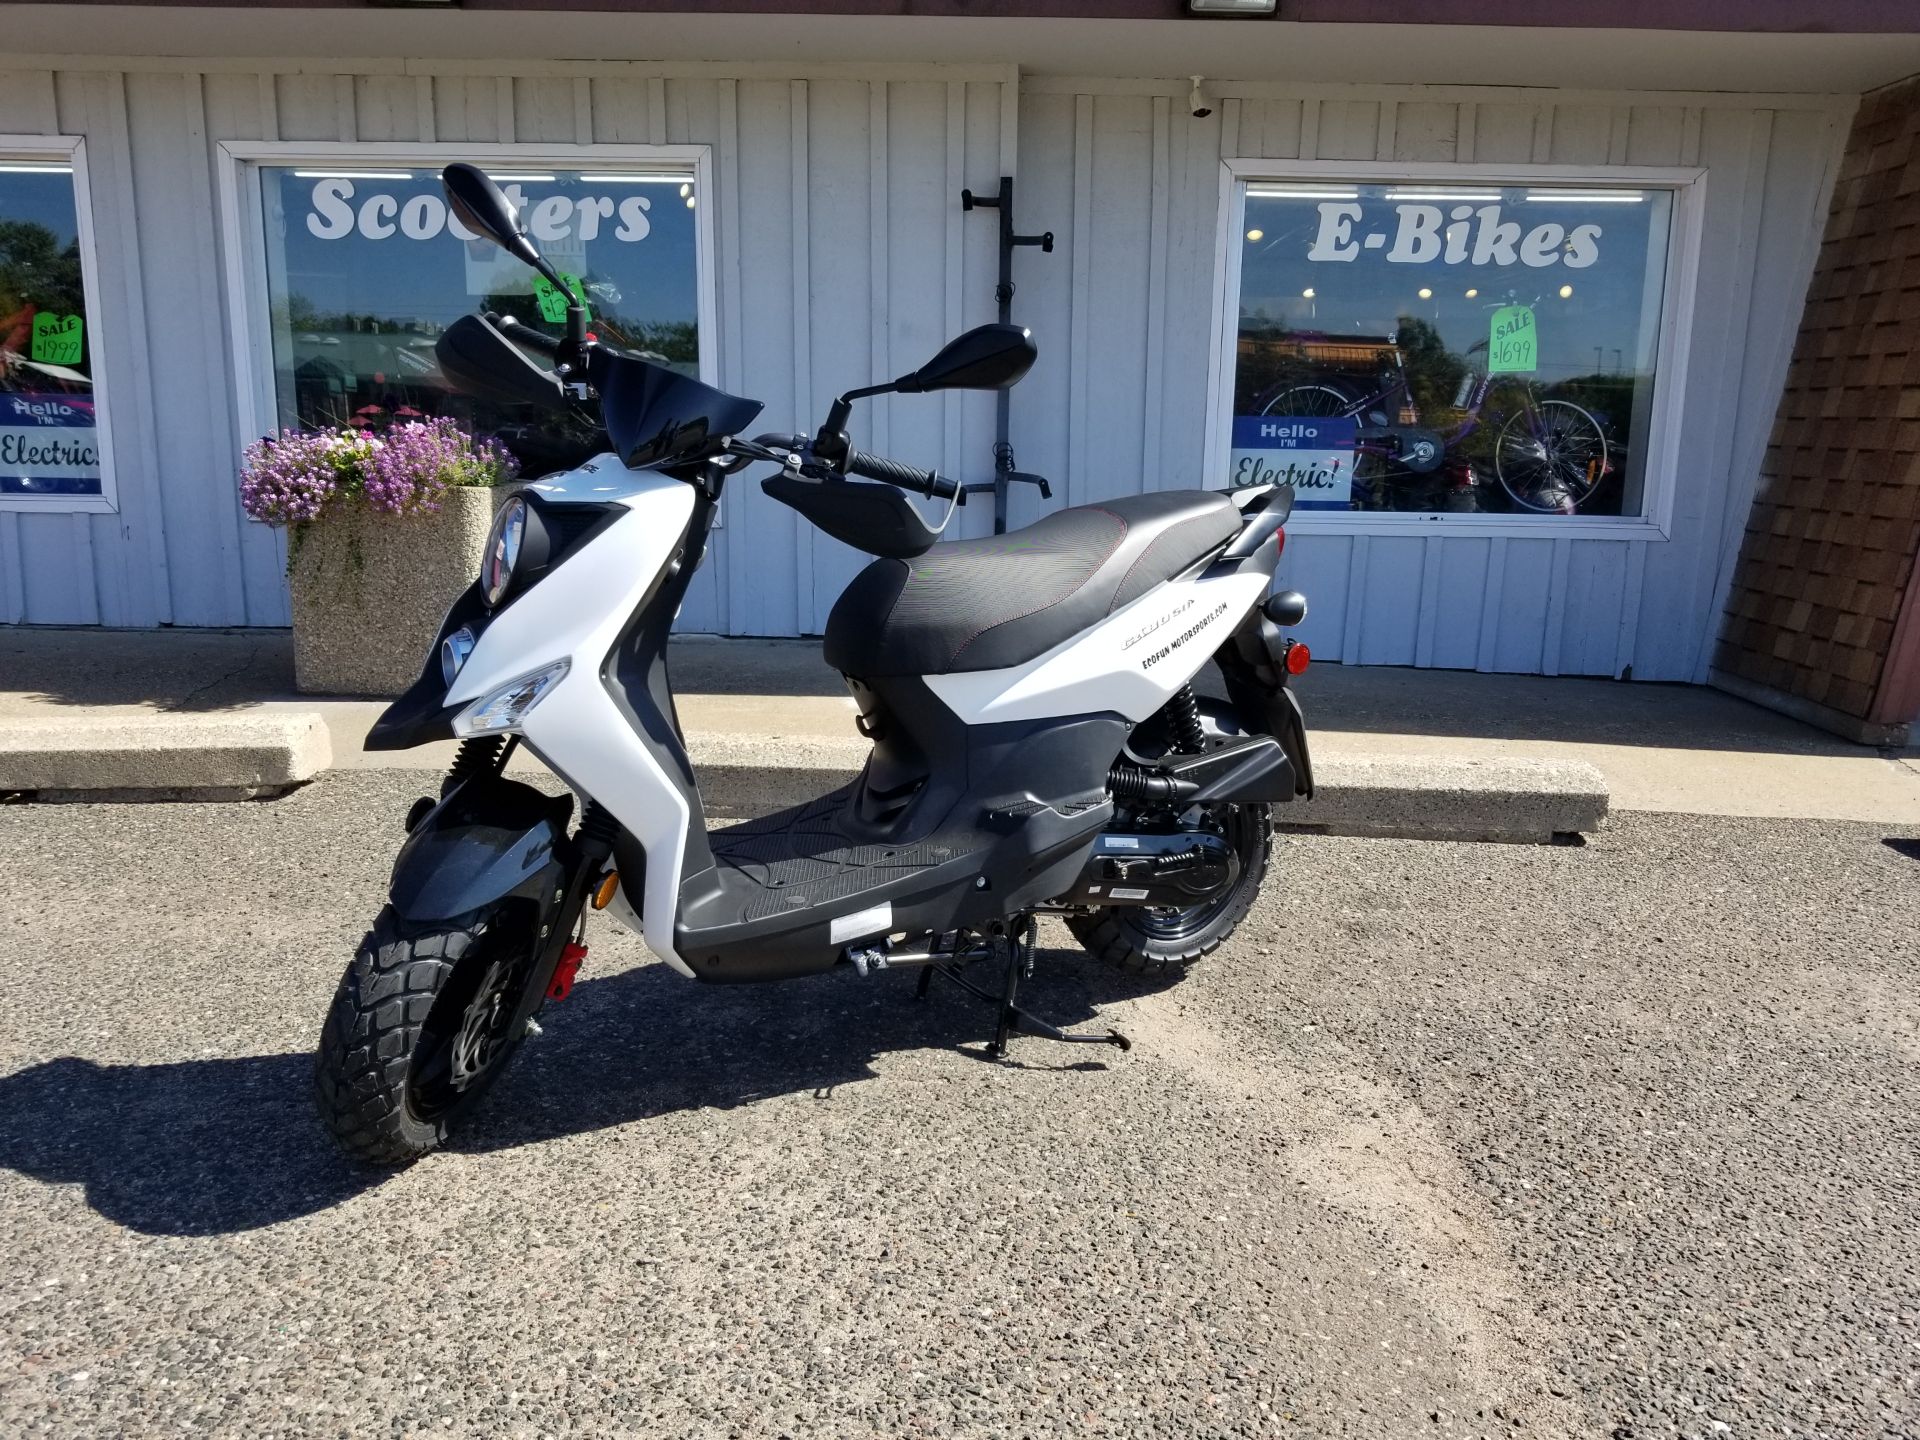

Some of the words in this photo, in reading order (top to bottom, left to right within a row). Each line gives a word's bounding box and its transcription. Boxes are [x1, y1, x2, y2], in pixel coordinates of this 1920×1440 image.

[1307, 202, 1602, 268] E-Bikes
[541, 275, 575, 297] SAE
[545, 297, 586, 318] $12
[38, 319, 77, 338] SALE
[1496, 311, 1531, 341] SALE
[36, 340, 79, 361] $1999
[1493, 340, 1531, 364] $1699
[14, 401, 73, 415] Hello
[37, 416, 54, 425] I'M
[1260, 424, 1318, 438] Hello
[1280, 439, 1297, 448] I'M
[1235, 457, 1339, 488] Electric!
[1142, 645, 1170, 670] ECOFUN
[1171, 602, 1227, 650] MOTORSPORTS.COM
